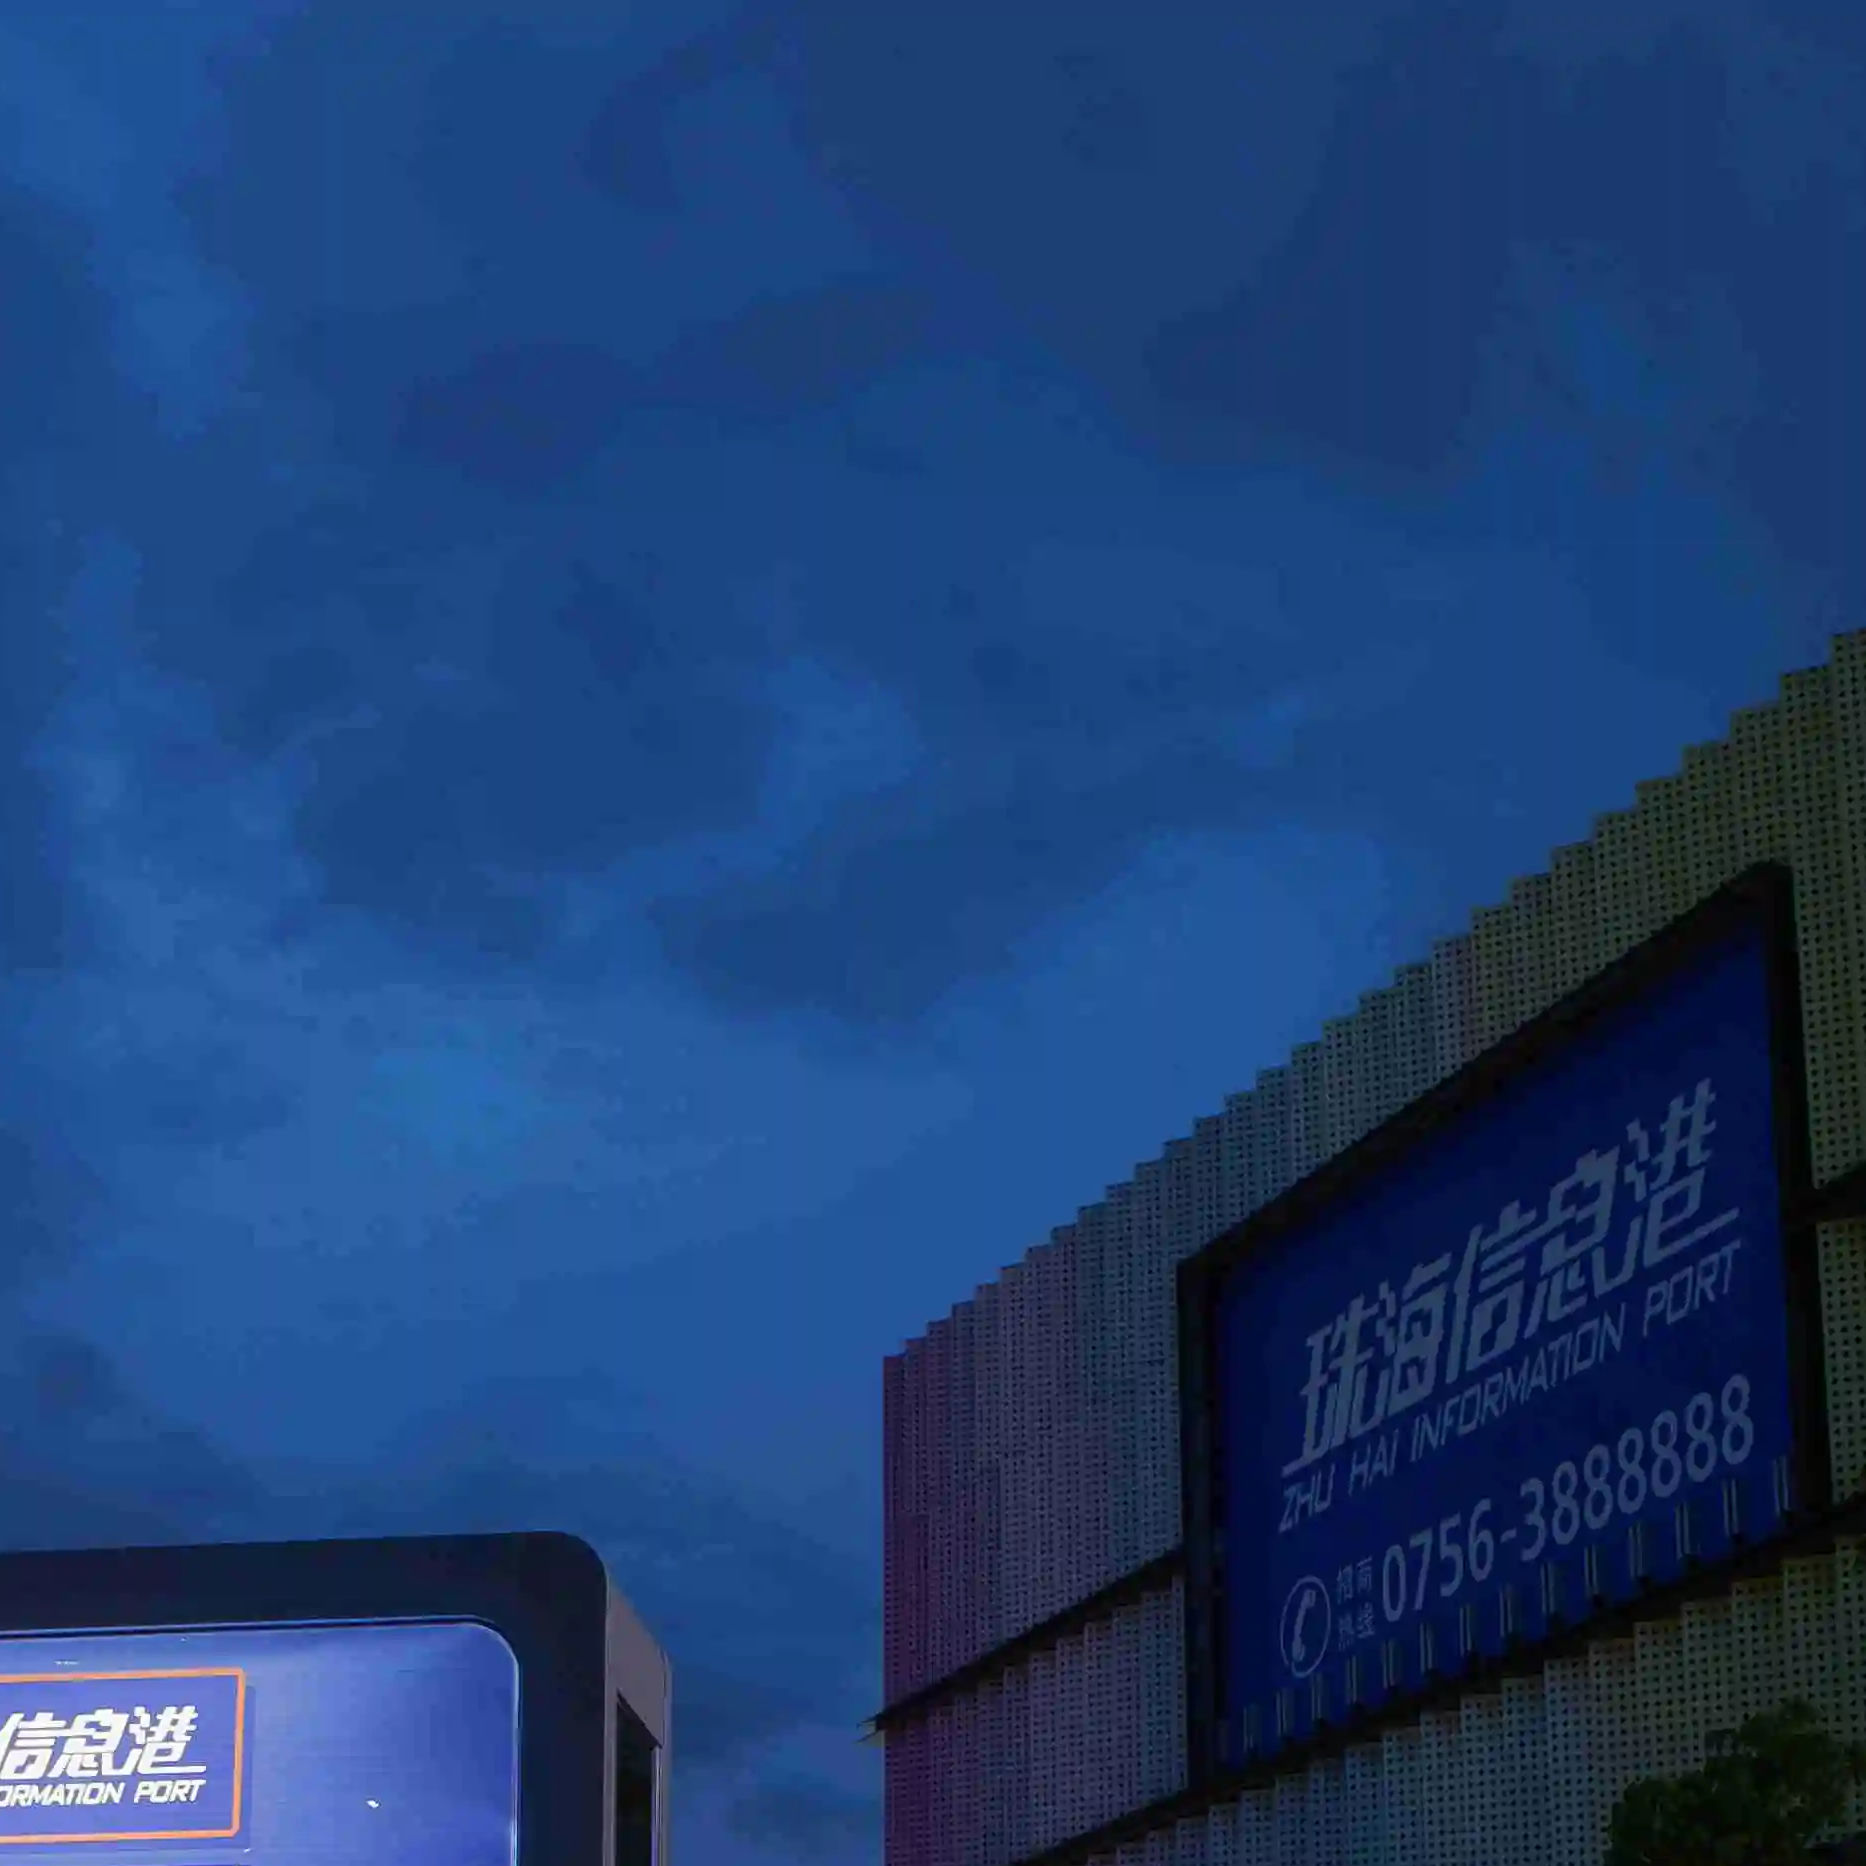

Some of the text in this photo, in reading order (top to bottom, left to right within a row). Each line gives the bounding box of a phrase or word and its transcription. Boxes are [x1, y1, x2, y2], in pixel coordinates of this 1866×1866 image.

[1279, 1240, 1740, 1532] ZHU HAI INFORMATION PORT
[1281, 1078, 1739, 1476] 珠海信息港
[1382, 1373, 1756, 1622] 0756-3888888
[134, 1779, 207, 1804] PORT
